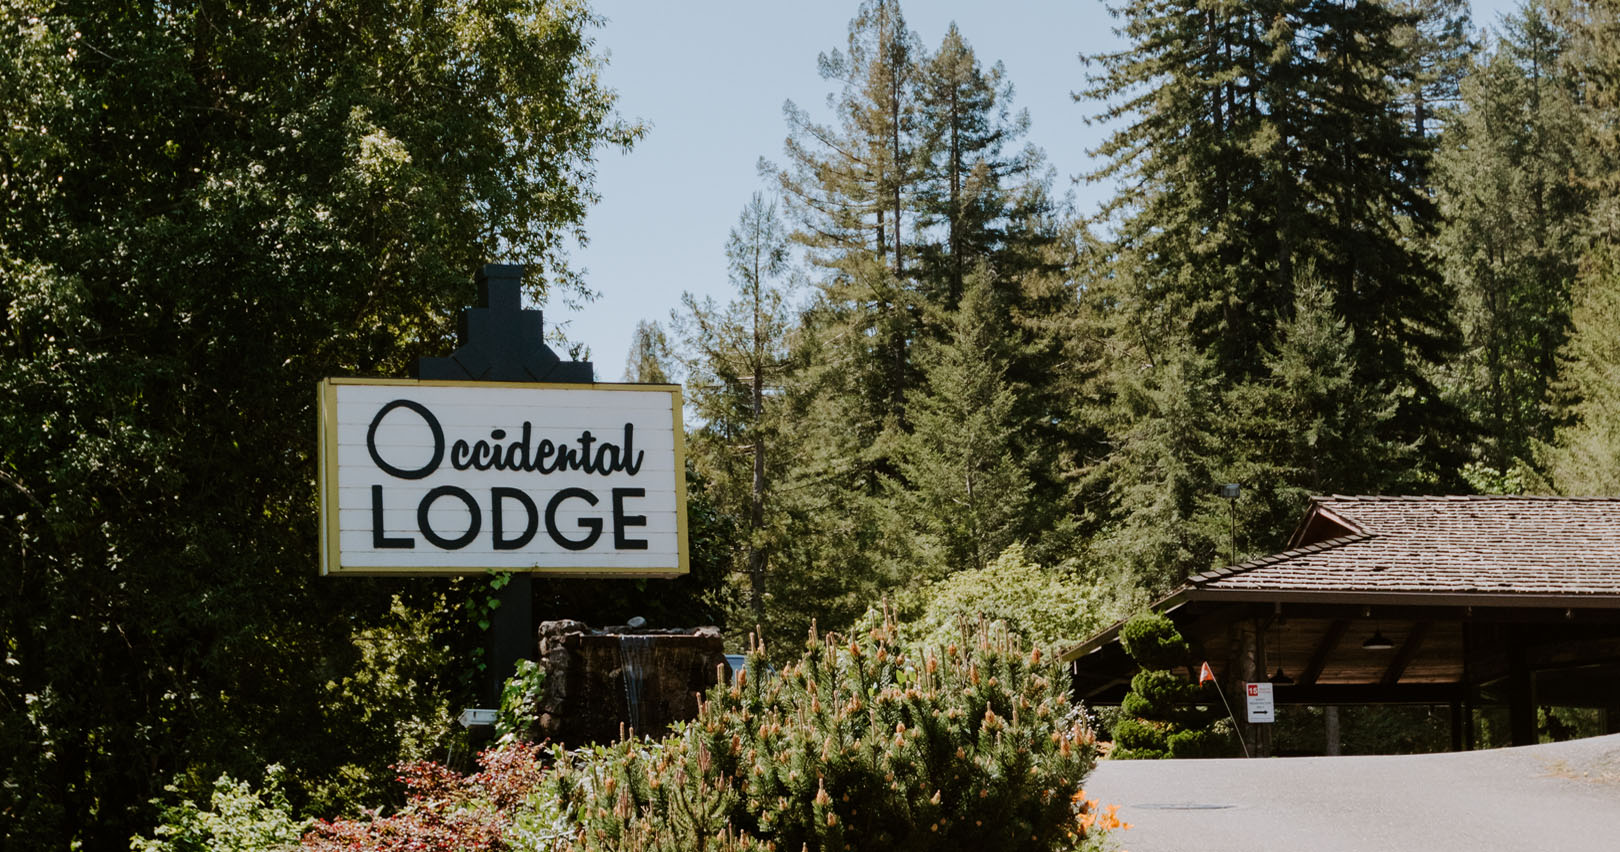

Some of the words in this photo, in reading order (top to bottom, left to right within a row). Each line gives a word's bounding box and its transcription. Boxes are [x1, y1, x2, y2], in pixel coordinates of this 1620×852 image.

[366, 398, 645, 480] Occidental
[370, 485, 648, 551] LODGE
[1249, 687, 1257, 695] 15
